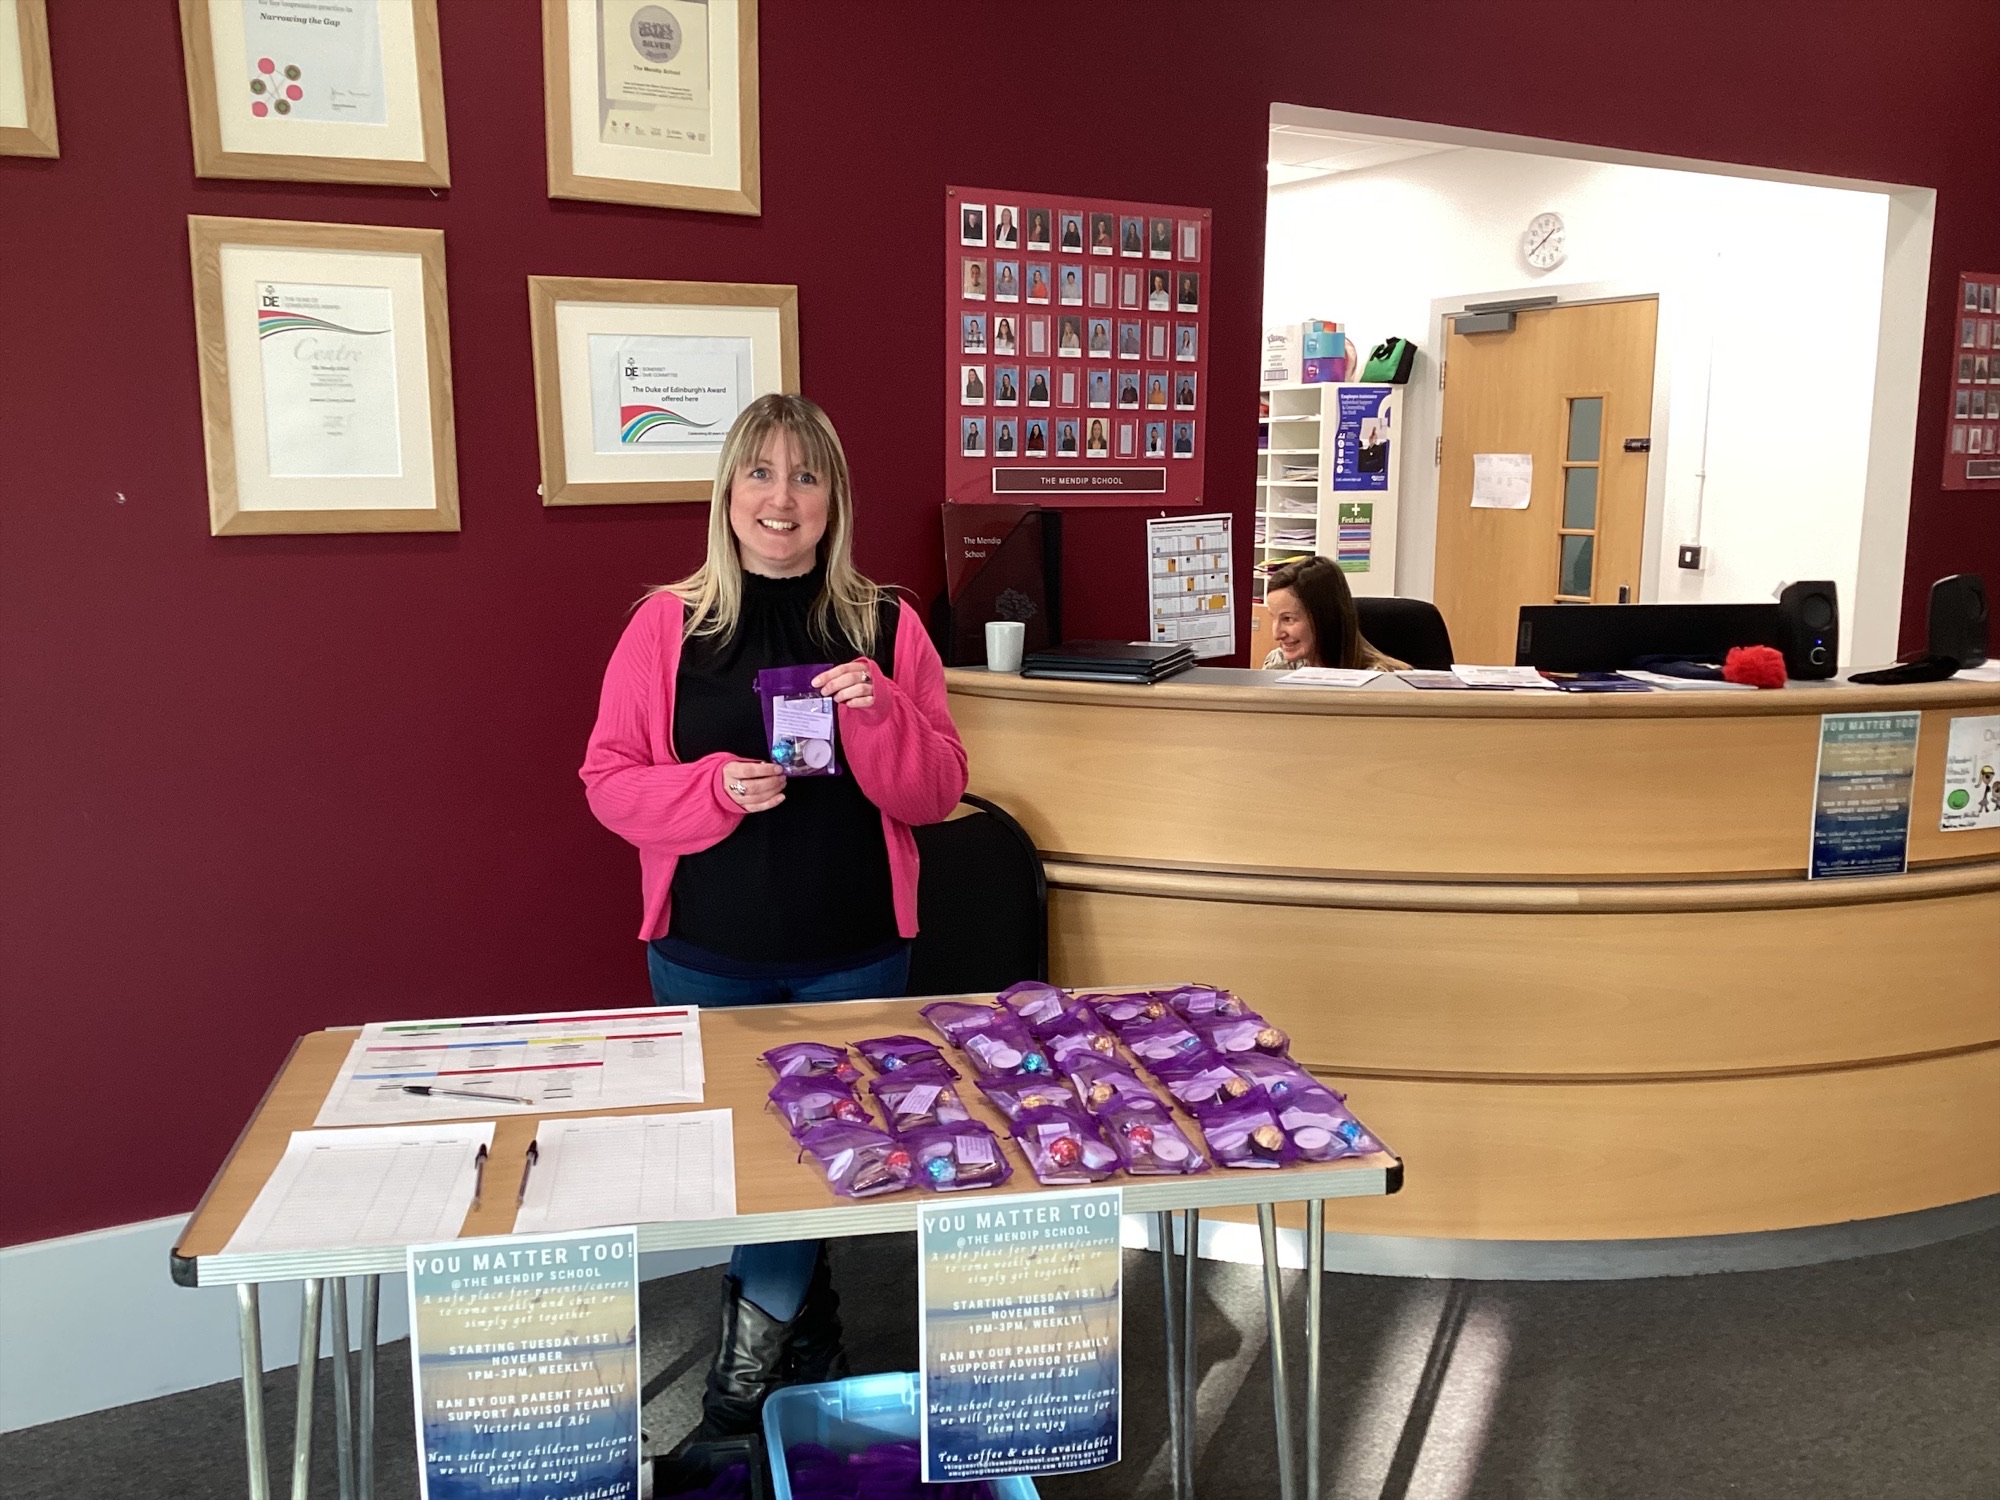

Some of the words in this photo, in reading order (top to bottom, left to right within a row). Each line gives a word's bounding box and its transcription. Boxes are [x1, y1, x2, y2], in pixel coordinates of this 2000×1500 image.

[260, 12, 307, 25] Narrowing
[308, 16, 322, 25] the
[323, 18, 341, 27] Gap
[642, 39, 671, 50] SILVER
[633, 64, 643, 72] The
[643, 66, 662, 75] Mendip
[663, 68, 681, 76] School
[293, 337, 363, 362] Centre
[670, 386, 706, 394] Edinburgh's
[1040, 476, 1057, 485] THE
[1058, 476, 1089, 485] MENDIP
[1091, 476, 1124, 485] SCHOOL
[963, 536, 976, 545] The
[976, 536, 1002, 546] Mendip
[964, 550, 986, 559] School
[1848, 719, 1891, 730] MATTER
[924, 1214, 965, 1233] YOU
[976, 1206, 1060, 1228] MATTER
[1070, 1199, 1120, 1220] TOO!
[956, 1234, 989, 1248] @THE
[994, 1229, 1038, 1242] MENDIP
[1044, 1224, 1090, 1237] SCHOOL
[414, 1255, 460, 1275] YOU
[472, 1247, 567, 1270] MATTER
[578, 1241, 632, 1261] TOO!
[943, 1249, 965, 1262] safe
[972, 1246, 1002, 1261] place
[1007, 1243, 1026, 1259] for
[1029, 1237, 1113, 1256] parents/carers
[961, 1262, 987, 1271] come
[992, 1254, 1030, 1269] weekly
[1035, 1252, 1057, 1264] and
[1061, 1252, 1085, 1262] chat
[451, 1276, 487, 1291] @THE
[493, 1271, 543, 1284] MENDIP
[549, 1267, 600, 1280] SCHOOL
[967, 1271, 1005, 1286] simply
[1009, 1270, 1028, 1284] get
[1034, 1264, 1082, 1281] together
[437, 1292, 461, 1306] safe
[469, 1289, 503, 1305] place
[508, 1286, 529, 1302] for
[534, 1280, 628, 1299] parents/carers
[952, 1296, 1012, 1310] STARTING
[1017, 1290, 1070, 1304] TUESDAY
[1075, 1287, 1094, 1298] 1ST
[439, 1308, 451, 1316] to
[457, 1305, 487, 1315] come
[492, 1298, 534, 1316] weekly
[540, 1295, 564, 1308] and
[568, 1294, 596, 1305] chat
[991, 1305, 1054, 1320] NOVEMBER
[464, 1315, 507, 1331] simply
[512, 1314, 532, 1328] get
[538, 1308, 592, 1325] together
[968, 1320, 1027, 1334] 1PM-3PM,
[1032, 1314, 1082, 1328] WEEKLY!
[448, 1341, 515, 1355] STARTING
[520, 1335, 579, 1349] TUESDAY
[585, 1333, 607, 1344] 1ST
[939, 1351, 963, 1362] RAN
[968, 1349, 983, 1359] BY
[988, 1346, 1011, 1357] OUR
[1016, 1342, 1062, 1355] PARENT
[1066, 1335, 1108, 1350] FAMILY
[491, 1351, 562, 1366] NOVEMBER
[949, 1359, 1003, 1373] SUPPORT
[1008, 1355, 1060, 1368] ADVISOR
[1065, 1350, 1096, 1363] TEAM
[466, 1367, 532, 1380] 1PM-3PM,
[538, 1360, 593, 1374] WEEKLY!
[972, 1372, 1024, 1384] Victoria
[1030, 1367, 1053, 1379] and
[1057, 1365, 1078, 1377] Abi
[436, 1398, 462, 1409] RAN
[468, 1396, 484, 1406] BY
[489, 1394, 515, 1405] OUR
[521, 1389, 571, 1402] PARENT
[577, 1382, 624, 1397] FAMILY
[930, 1403, 952, 1413] Non
[957, 1396, 992, 1411] school
[997, 1399, 1016, 1411] age
[1020, 1392, 1068, 1405] children
[447, 1408, 507, 1421] SUPPORT
[512, 1402, 569, 1417] ADVISOR
[575, 1398, 609, 1411] TEAM
[940, 1417, 953, 1425] we
[959, 1411, 981, 1423] will
[982, 1407, 1028, 1425] provide
[1032, 1404, 1088, 1416] activities
[1093, 1400, 1110, 1415] for
[473, 1421, 530, 1434] Victoria
[537, 1415, 563, 1429] and
[567, 1413, 590, 1426] Abi
[987, 1422, 1013, 1434] them
[1019, 1422, 1030, 1431] to
[1035, 1419, 1065, 1433] enjoy
[428, 1452, 451, 1462] Non
[457, 1447, 497, 1461] school
[501, 1450, 521, 1461] age
[527, 1442, 579, 1456] children
[459, 1461, 484, 1473] will
[486, 1458, 535, 1476] provide
[541, 1453, 601, 1468] activities
[606, 1448, 627, 1463] for
[938, 1450, 962, 1462] Tea,
[966, 1447, 1004, 1468] coffee
[1007, 1447, 1017, 1457] &
[1021, 1443, 1046, 1456] cake
[491, 1474, 519, 1485] them
[526, 1473, 538, 1482] to
[543, 1470, 577, 1483] enjoy
